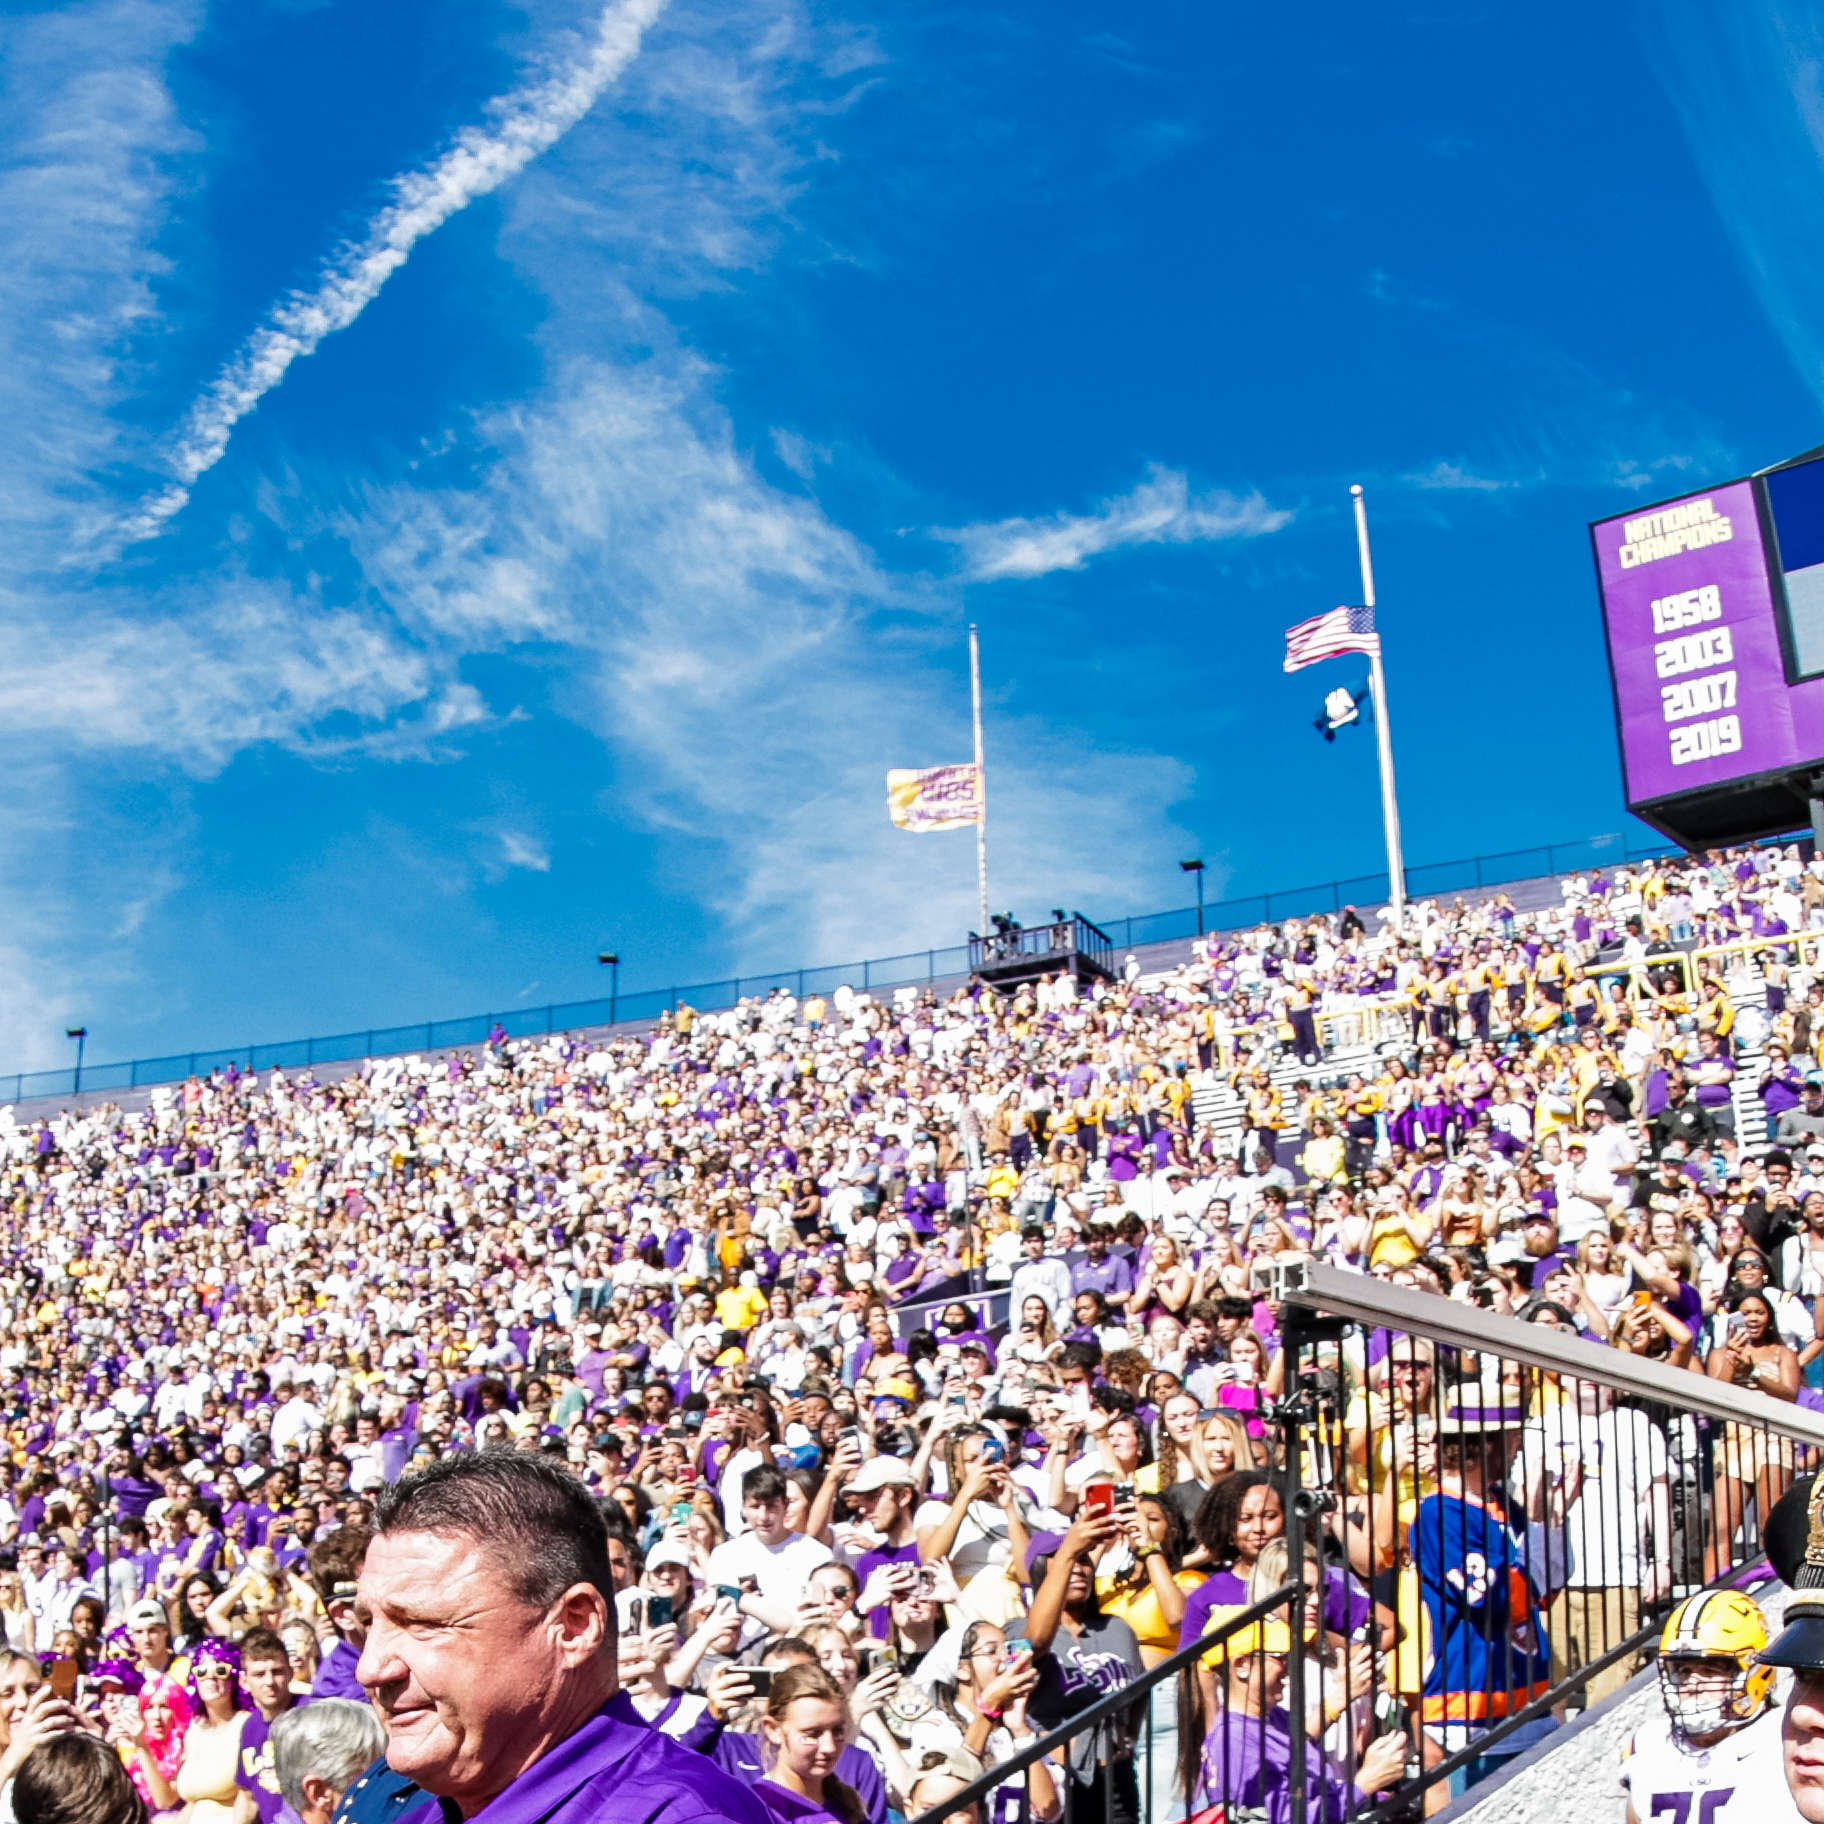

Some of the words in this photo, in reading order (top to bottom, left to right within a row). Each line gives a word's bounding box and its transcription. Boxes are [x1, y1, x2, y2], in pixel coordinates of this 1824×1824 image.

[1619, 517, 1733, 568] CHAMPIONS
[1624, 499, 1720, 543] NATIONAL
[1651, 584, 1722, 634] 1958
[1654, 626, 1734, 678] 2003
[1661, 671, 1737, 722] 2007
[1669, 715, 1742, 766] 2019
